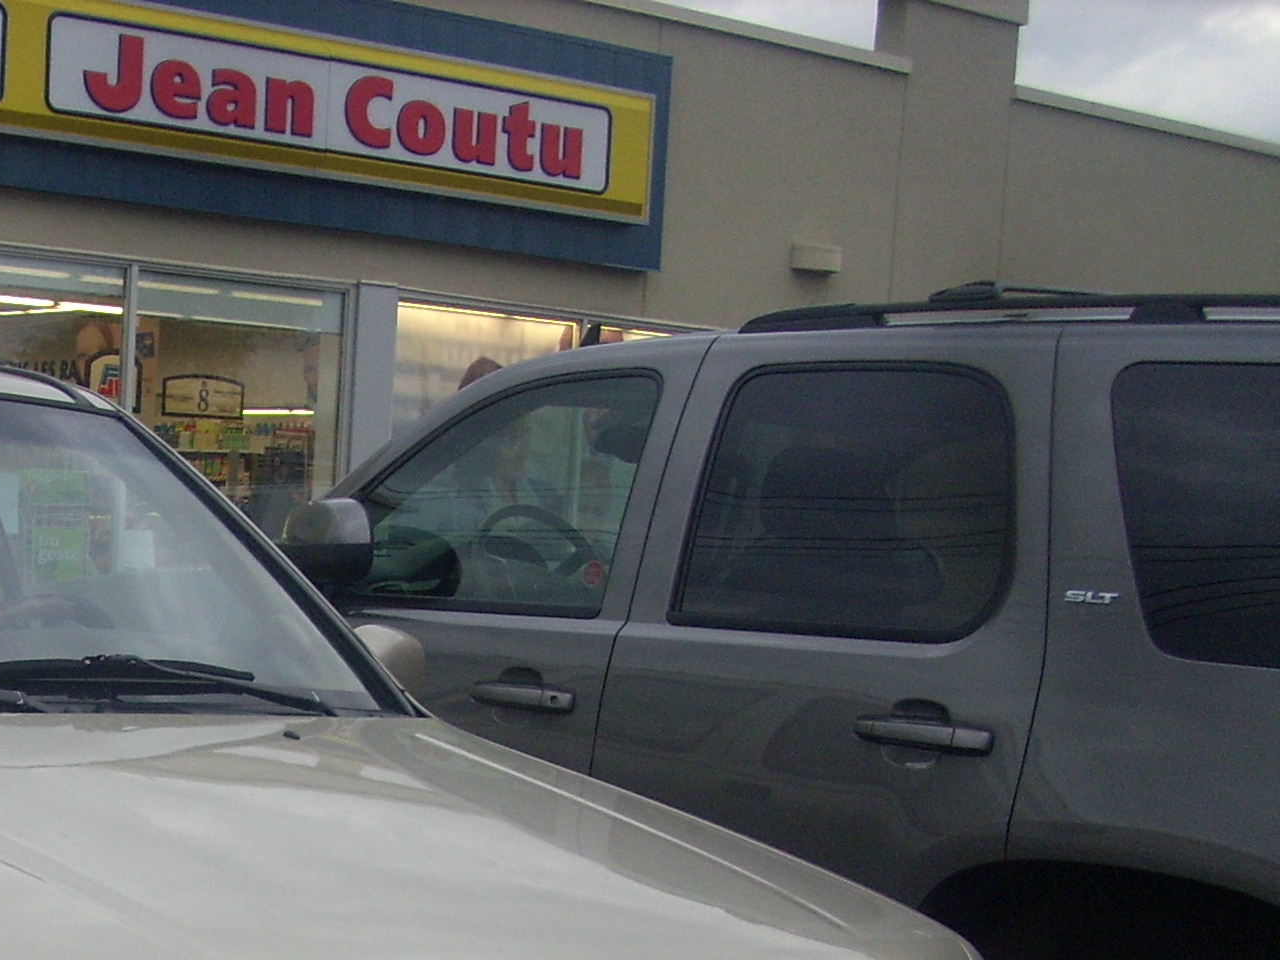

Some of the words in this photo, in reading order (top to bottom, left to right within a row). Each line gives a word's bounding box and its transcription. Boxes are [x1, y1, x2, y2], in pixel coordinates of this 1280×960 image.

[83, 33, 314, 138] Jean
[344, 75, 584, 180] Coutu
[197, 387, 210, 412] 8
[1063, 589, 1120, 605] SLT
